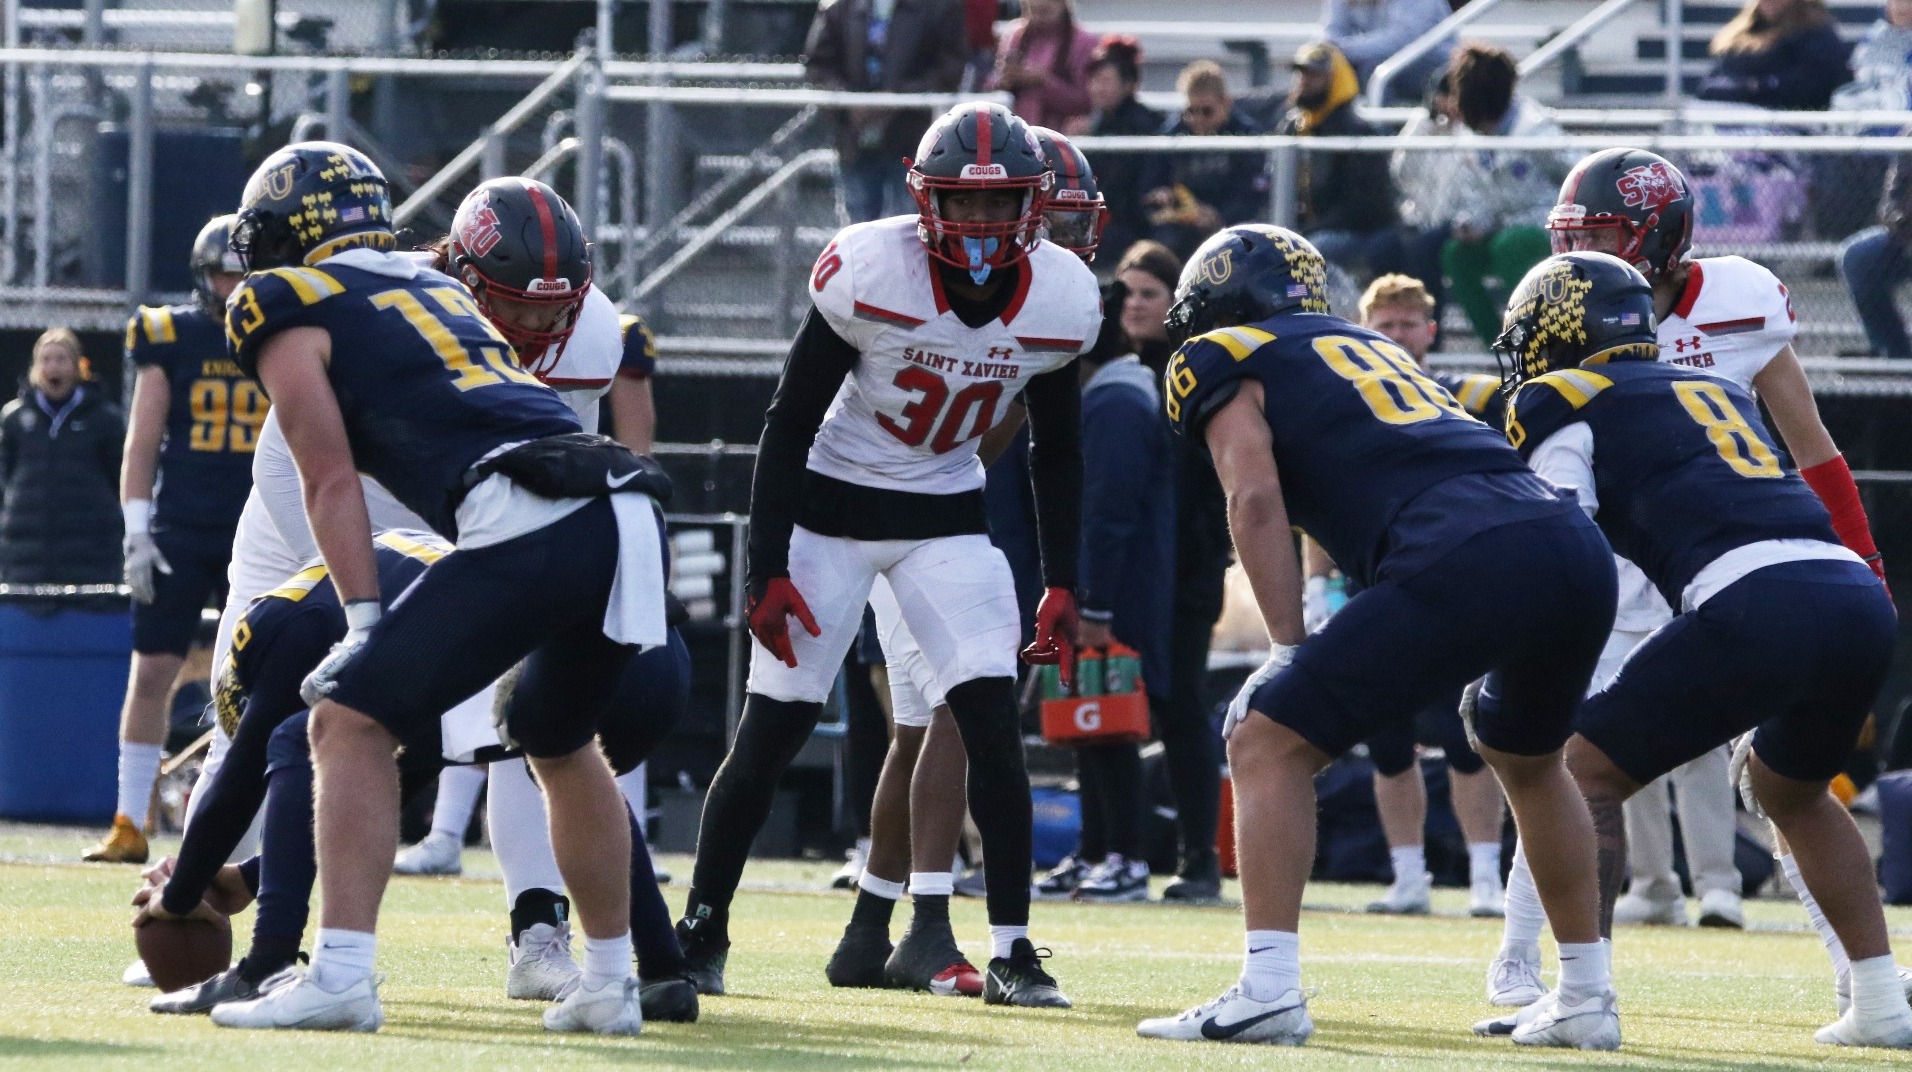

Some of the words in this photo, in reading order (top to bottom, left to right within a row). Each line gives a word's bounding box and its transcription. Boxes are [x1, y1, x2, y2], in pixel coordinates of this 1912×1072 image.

[968, 166, 1001, 175] COUGS
[1060, 190, 1086, 200] COUGS
[536, 281, 566, 291] COUGS
[902, 346, 959, 373] SAINT
[961, 360, 1020, 379] XAVIER
[189, 378, 272, 453] 99
[874, 363, 1005, 456] 30
[1670, 380, 1786, 478] 8
[1073, 701, 1102, 732] G
